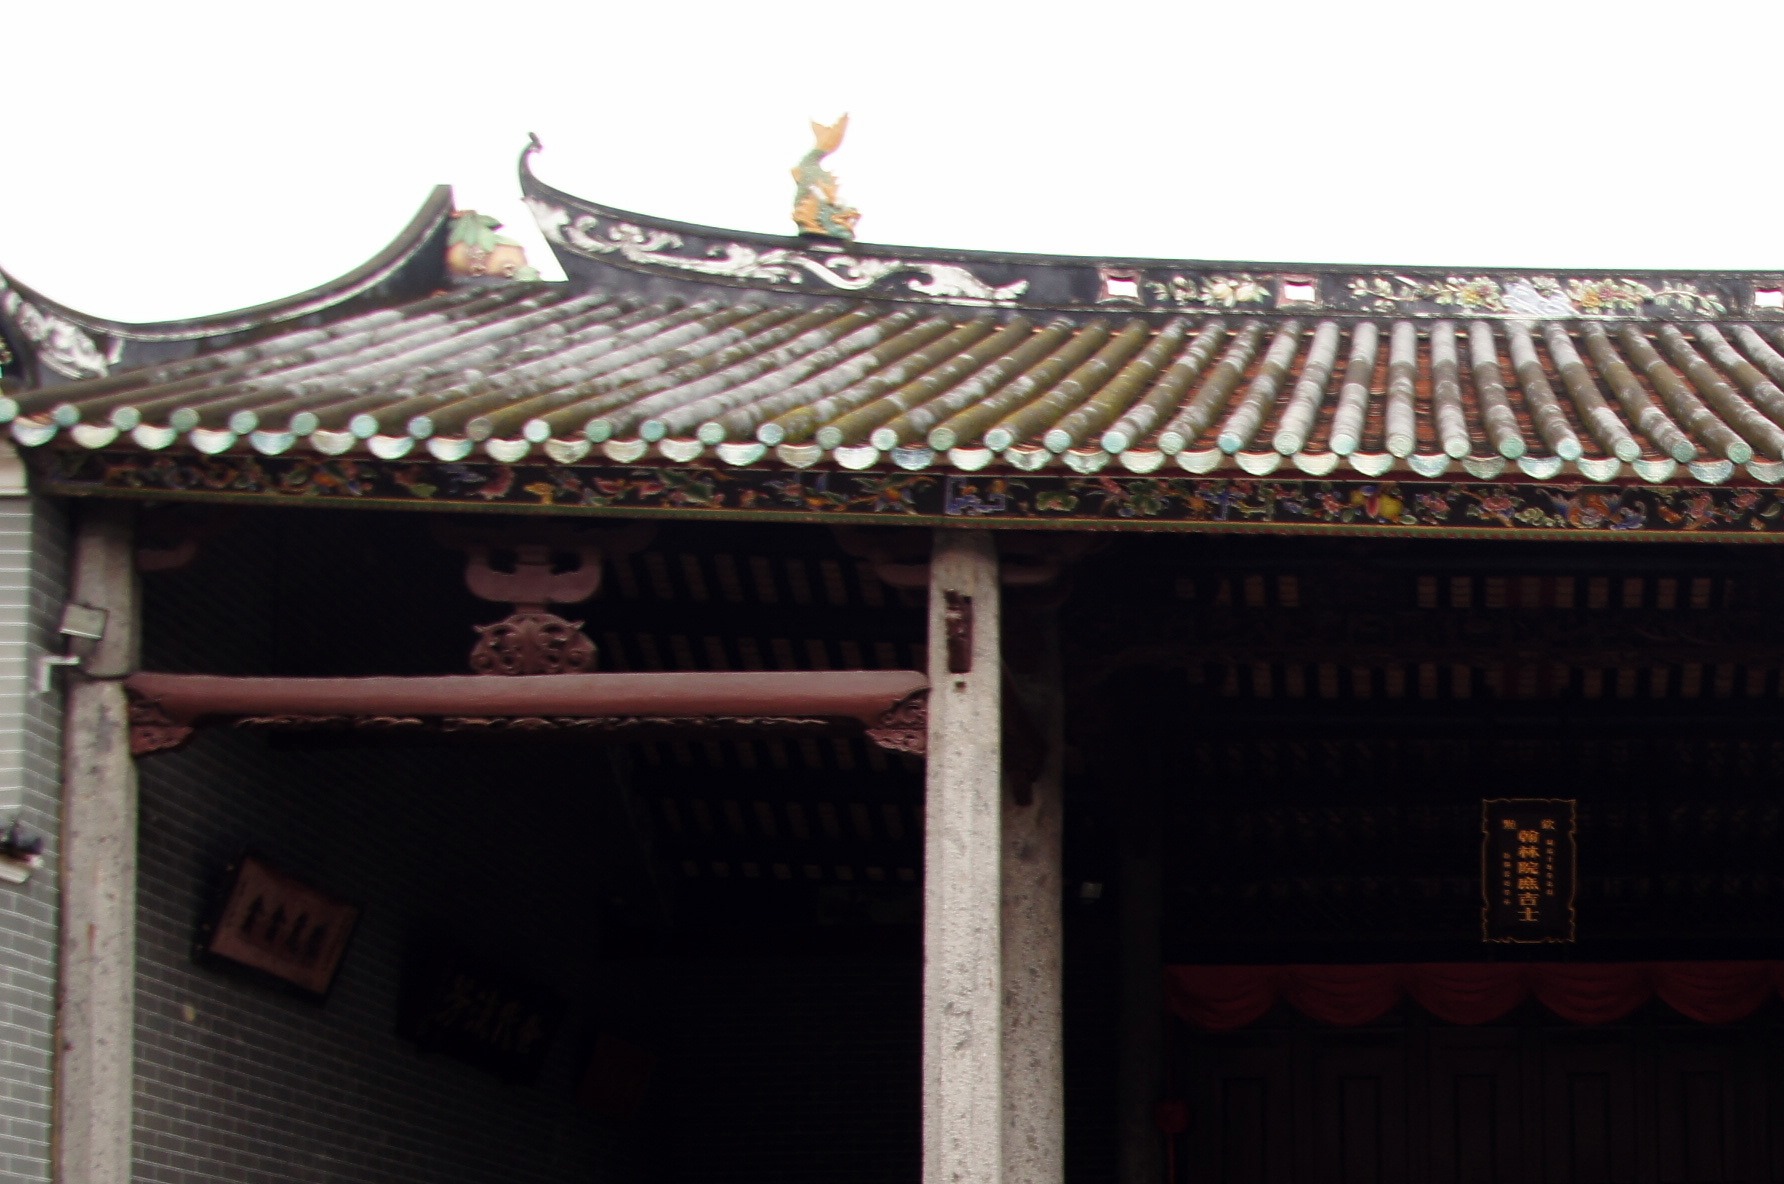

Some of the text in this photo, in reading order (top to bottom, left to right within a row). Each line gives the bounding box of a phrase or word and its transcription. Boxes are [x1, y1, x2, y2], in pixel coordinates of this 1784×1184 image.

[1517, 830, 1540, 922] 翰林院庶吉士
